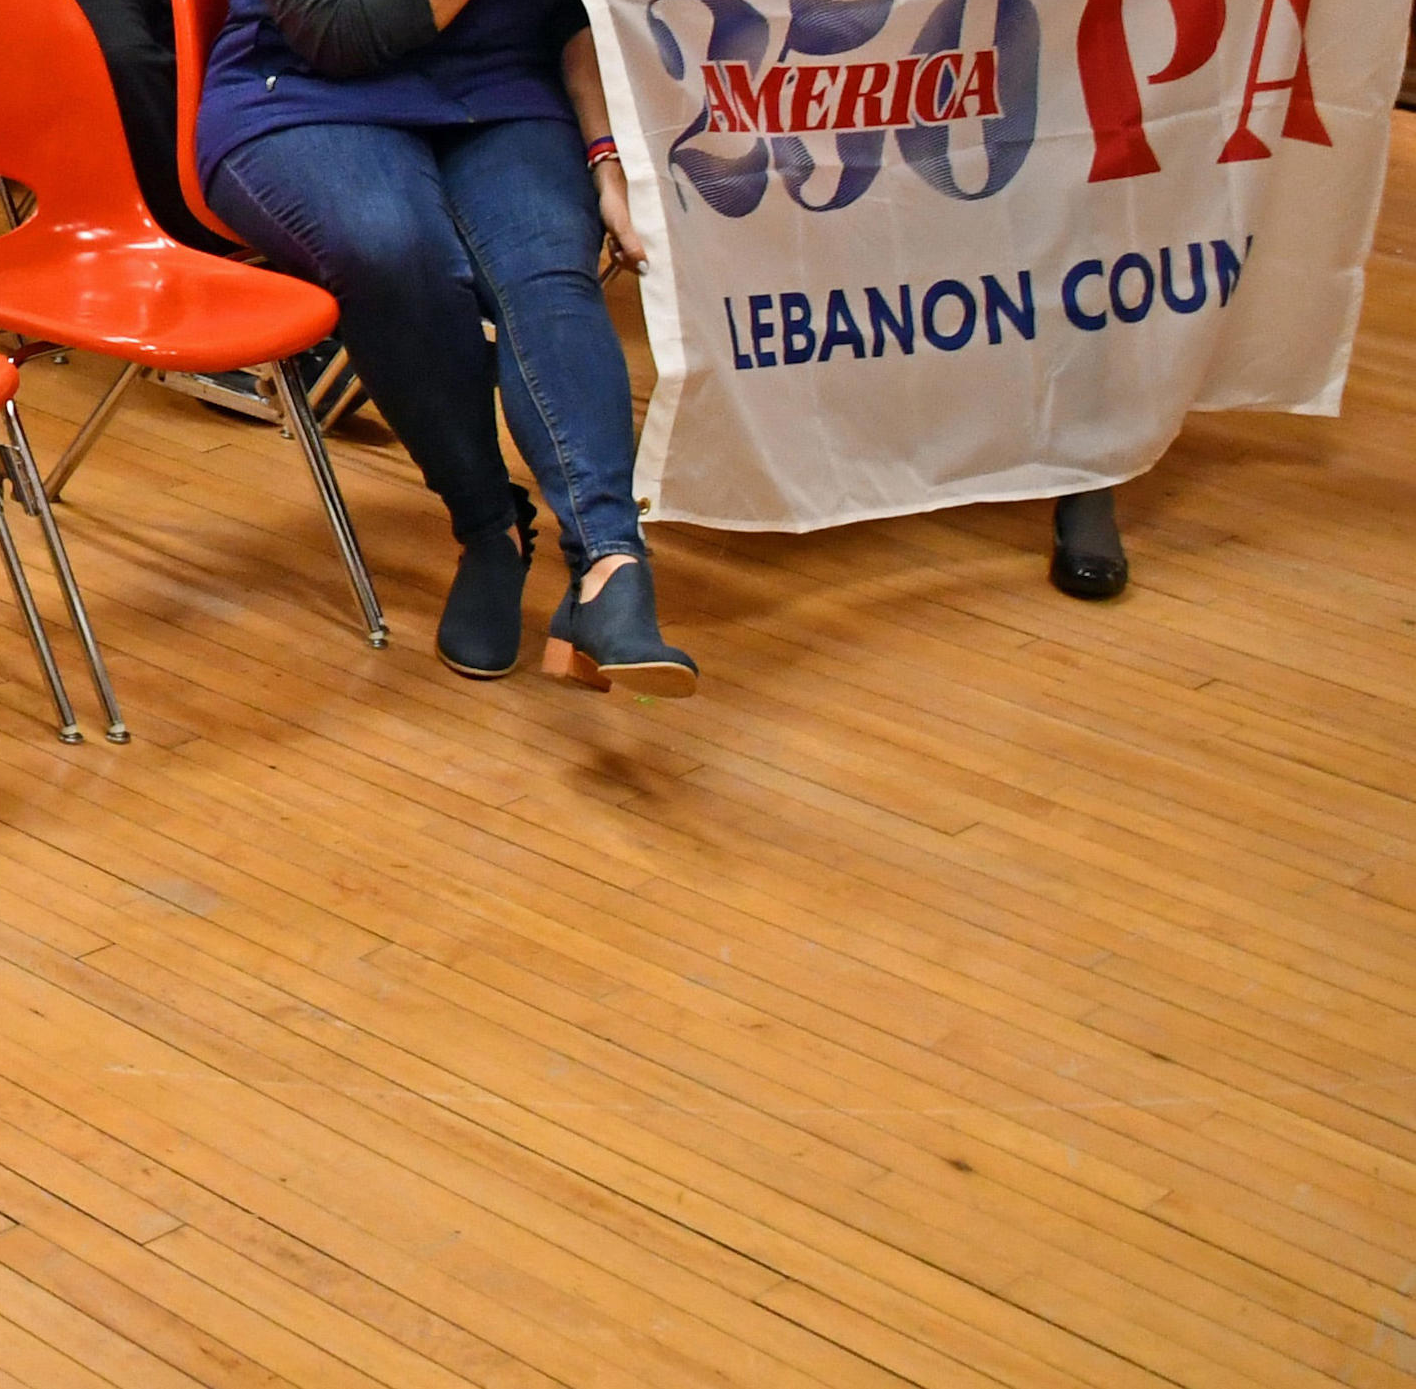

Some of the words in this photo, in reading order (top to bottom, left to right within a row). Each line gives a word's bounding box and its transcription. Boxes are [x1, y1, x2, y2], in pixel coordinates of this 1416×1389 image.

[700, 49, 1001, 134] AMERICA
[724, 270, 1036, 371] LEBANON
[1062, 234, 1253, 331] COUN
